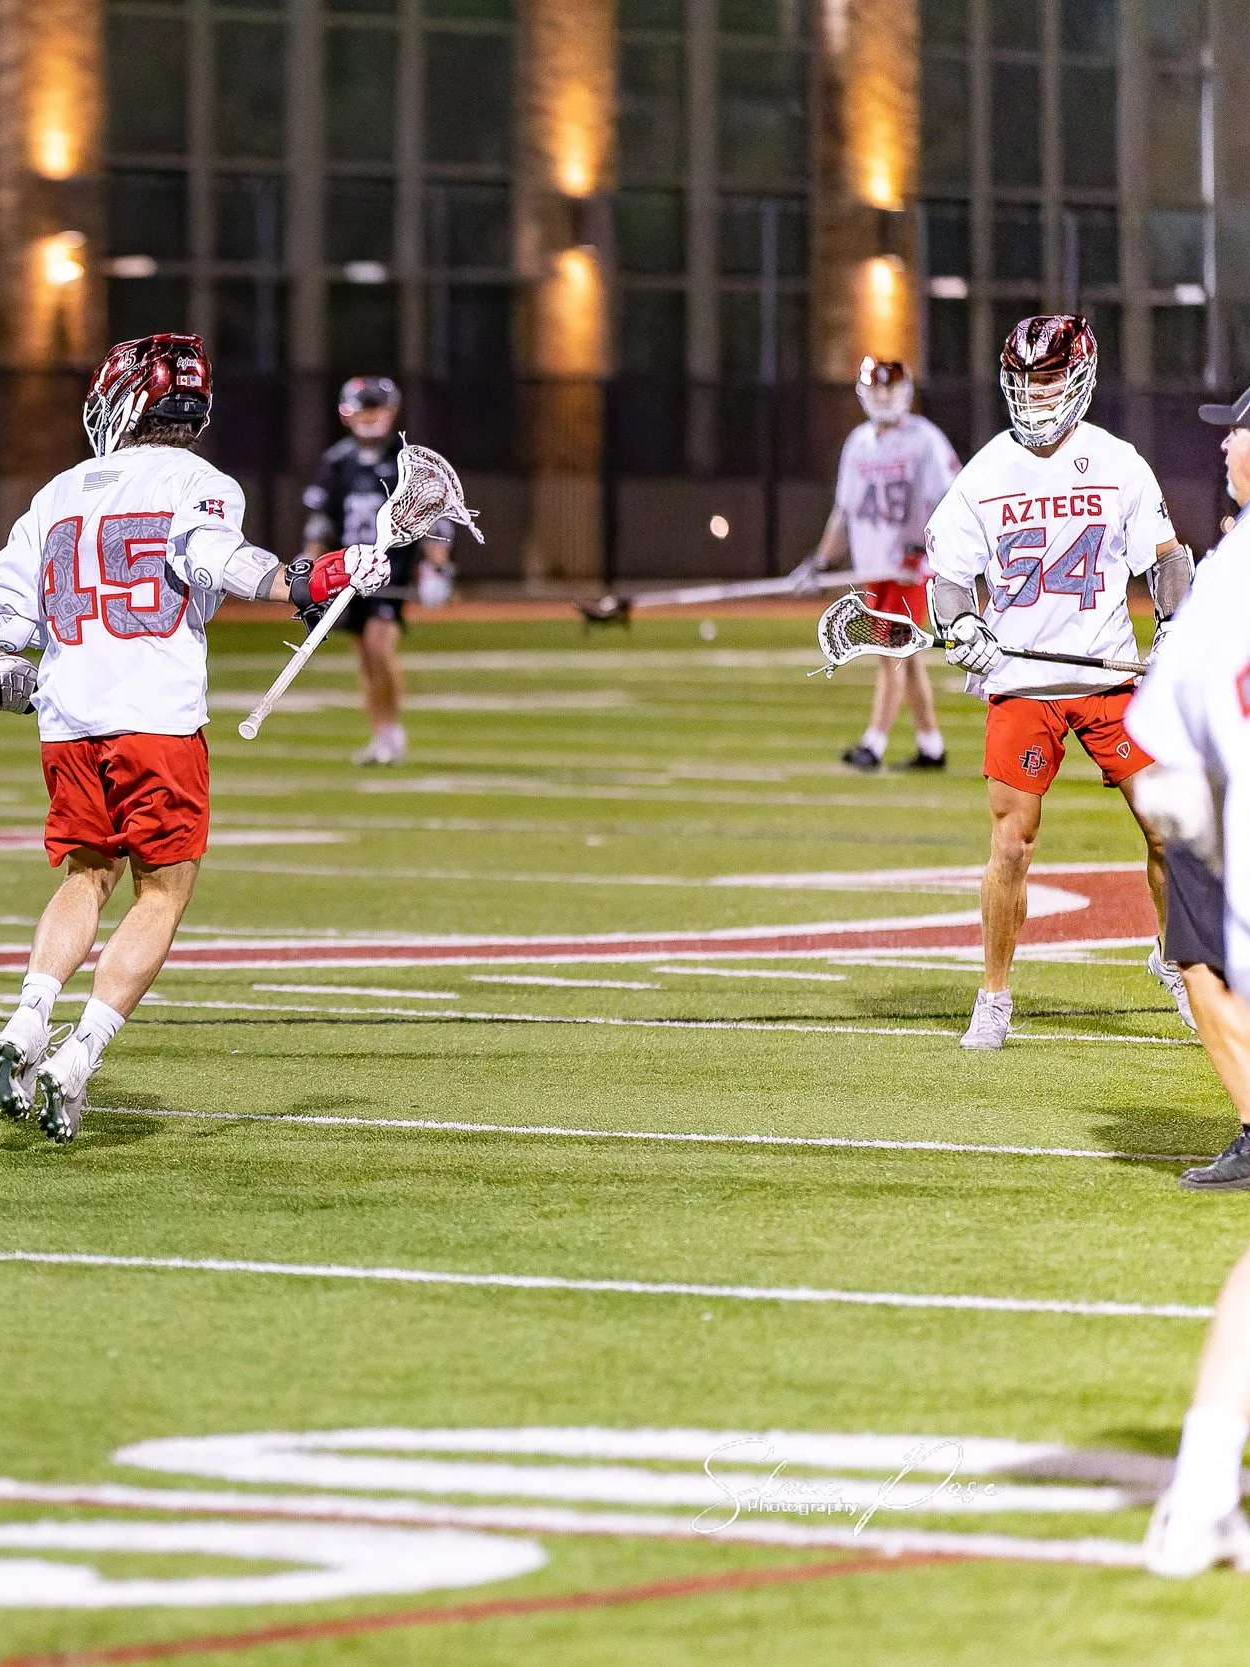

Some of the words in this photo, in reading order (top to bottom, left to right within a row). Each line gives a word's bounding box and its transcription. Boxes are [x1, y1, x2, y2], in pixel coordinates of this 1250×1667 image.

[1001, 494, 1103, 527] AZTECS
[40, 511, 190, 646] 45
[993, 523, 1107, 613] 54
